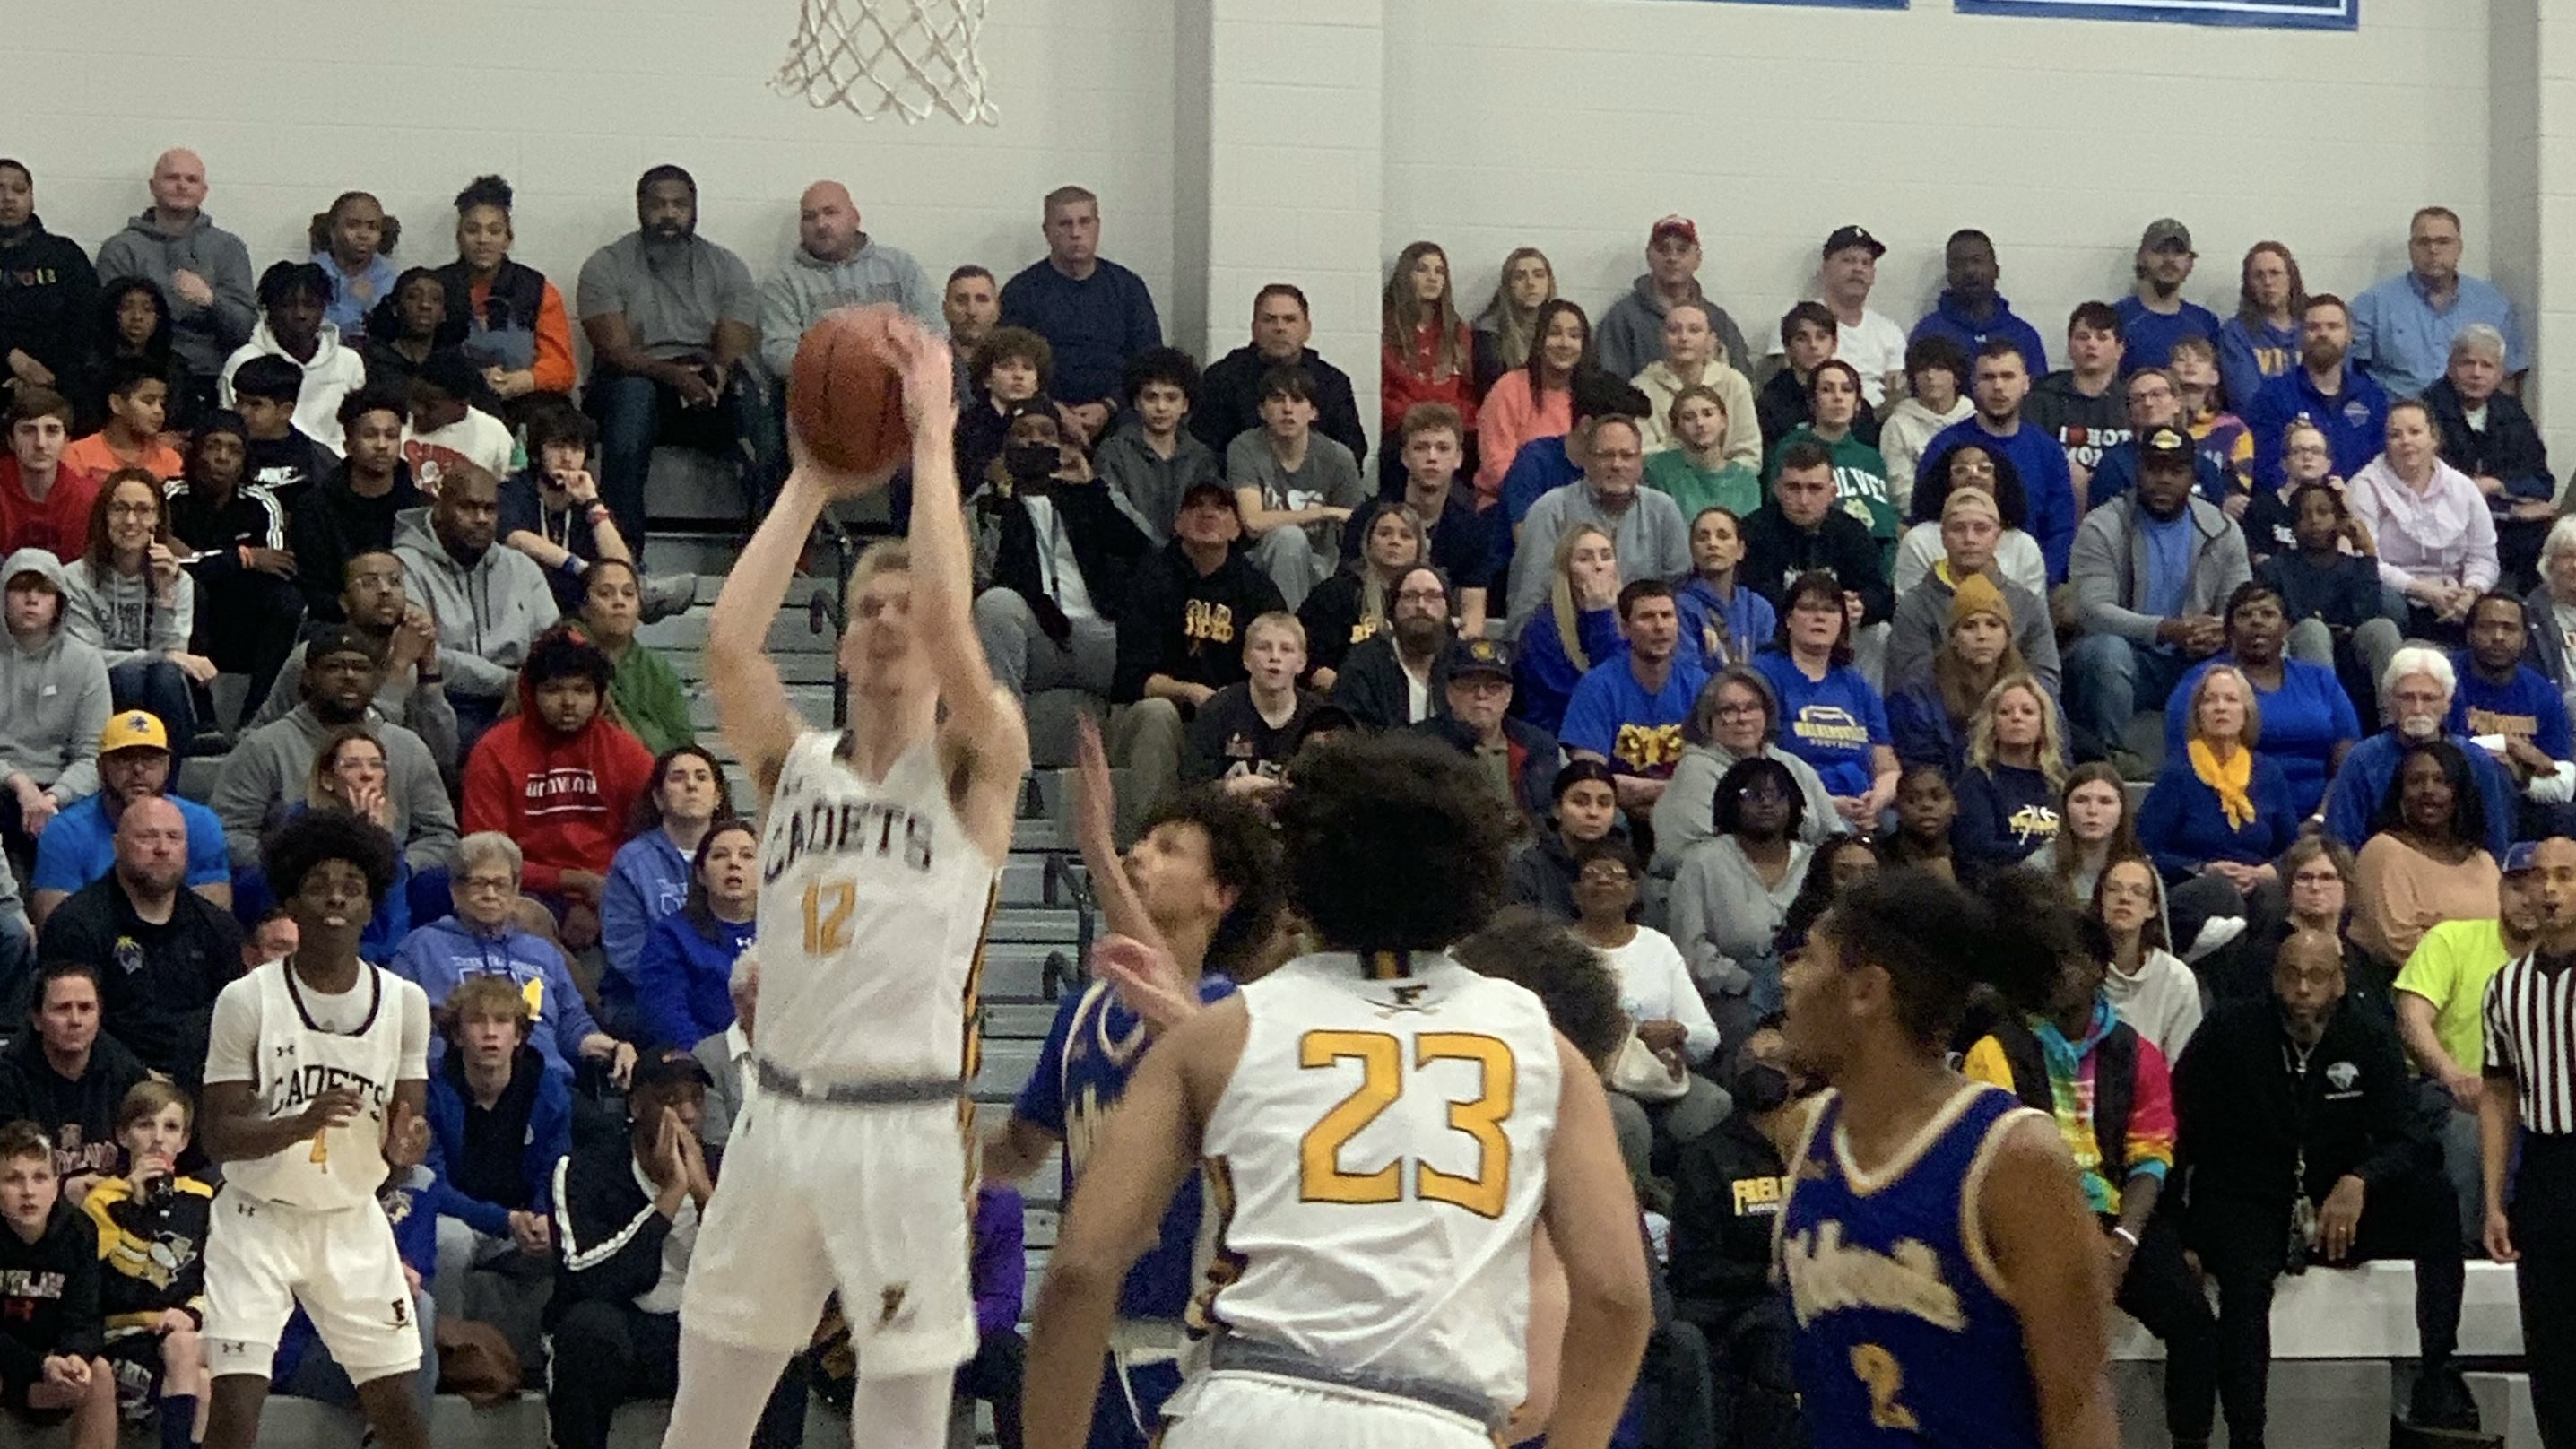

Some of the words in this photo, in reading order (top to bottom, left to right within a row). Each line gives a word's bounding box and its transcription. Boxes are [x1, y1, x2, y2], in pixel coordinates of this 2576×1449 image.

[763, 799, 935, 886] CADETS
[801, 877, 858, 958] 12
[1298, 1028, 1519, 1221] 23
[1849, 1342, 1920, 1428] 2
